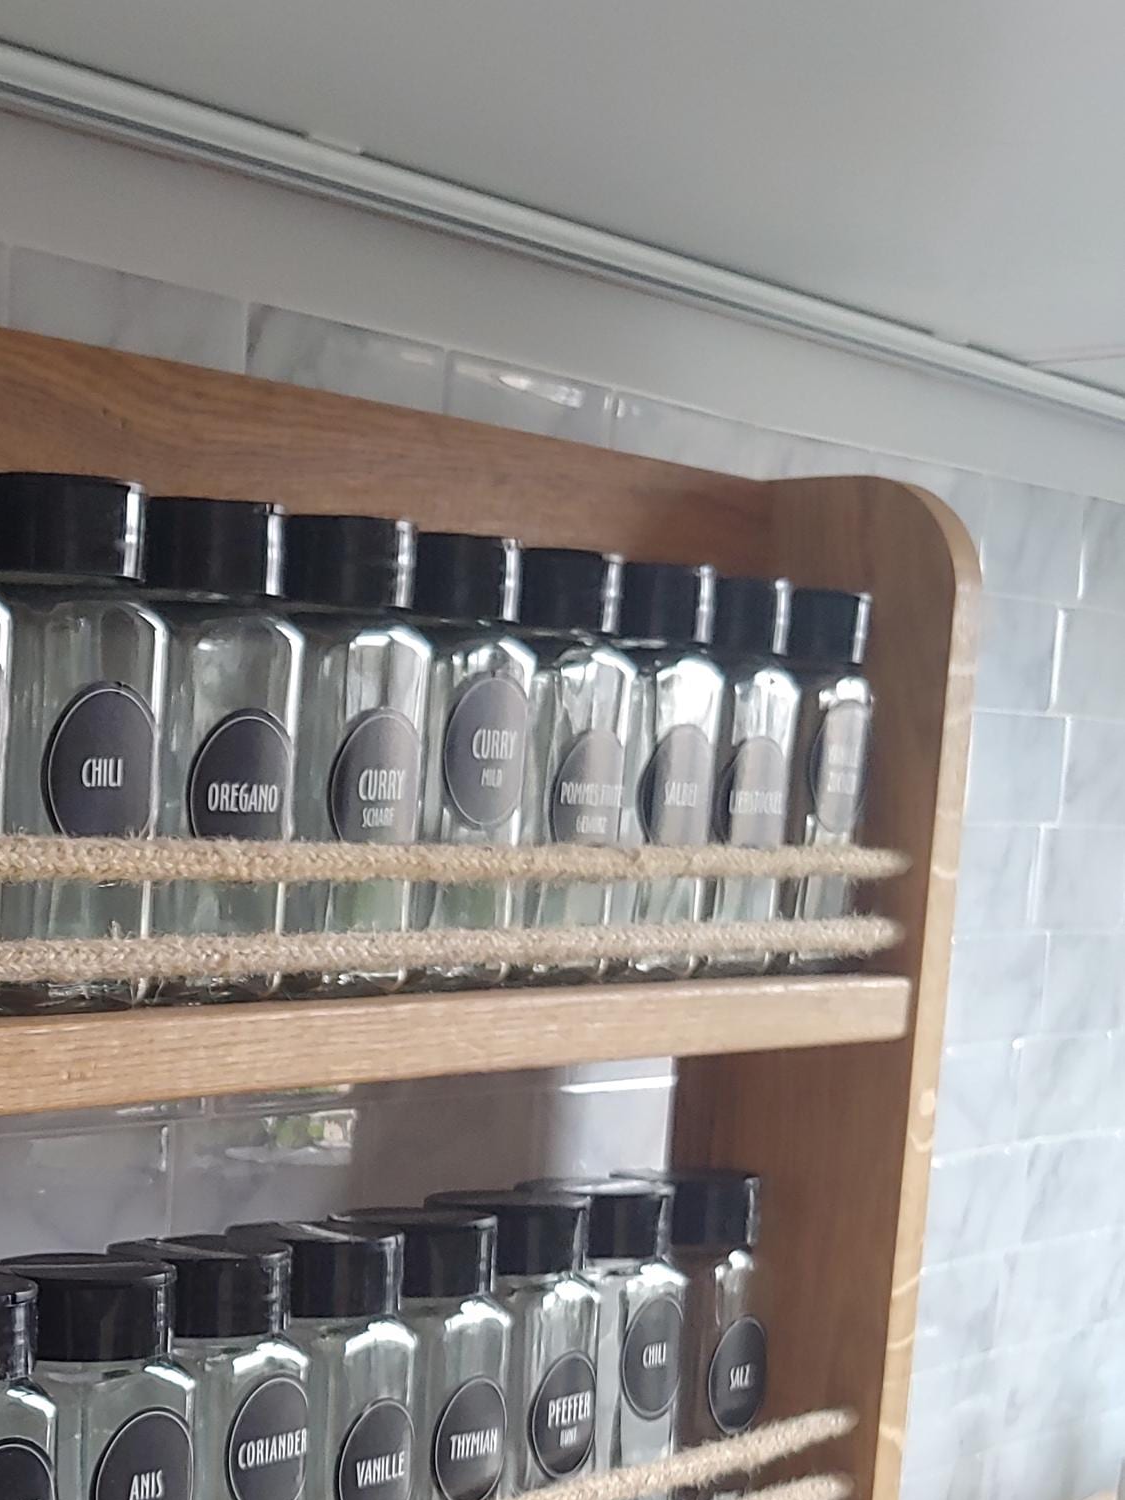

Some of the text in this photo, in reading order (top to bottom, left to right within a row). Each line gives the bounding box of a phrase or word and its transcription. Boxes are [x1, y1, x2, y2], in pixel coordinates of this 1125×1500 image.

[472, 728, 517, 760] CURRY
[81, 757, 124, 788] CHILI
[358, 768, 406, 802] CURRY
[481, 767, 503, 788] MILD
[207, 782, 278, 813] OREGANO
[643, 1341, 667, 1369] CHILI
[729, 1363, 751, 1391] SALZ
[547, 1390, 591, 1429] PFEFFER
[238, 1427, 307, 1471] CORIANDER
[450, 1428, 498, 1461] THYMIAN
[356, 1450, 405, 1489] VANILLE
